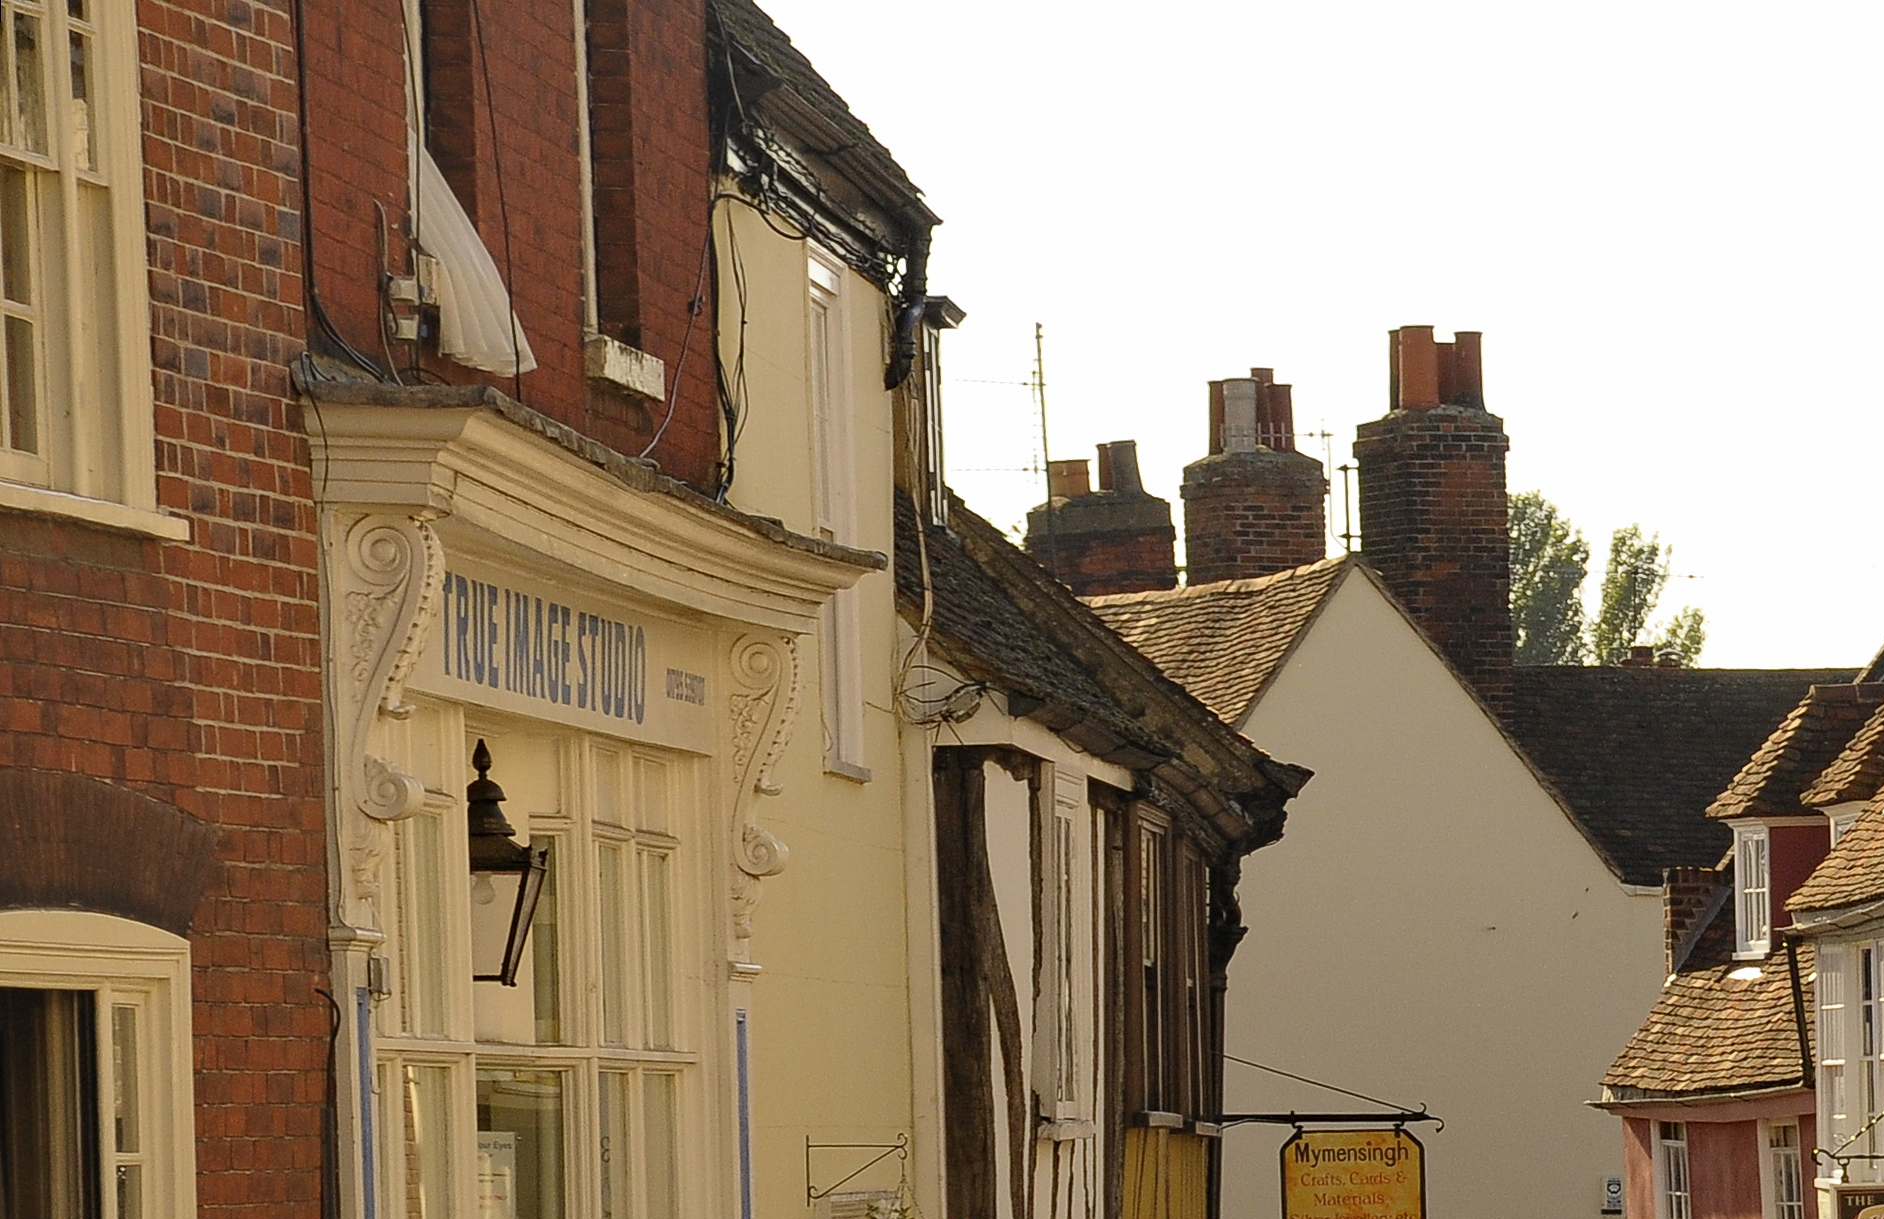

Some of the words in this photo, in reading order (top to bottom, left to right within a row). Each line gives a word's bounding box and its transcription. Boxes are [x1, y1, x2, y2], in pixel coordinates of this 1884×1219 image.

[443, 571, 499, 689] TRUE
[505, 588, 572, 705] IMAGE
[577, 611, 646, 725] STUDIO
[1294, 1140, 1409, 1168] Mymensingh
[1301, 1173, 1346, 1187] Crafts,
[1349, 1171, 1391, 1185] Cards
[1395, 1170, 1407, 1184] &
[1845, 1195, 1875, 1206] THE
